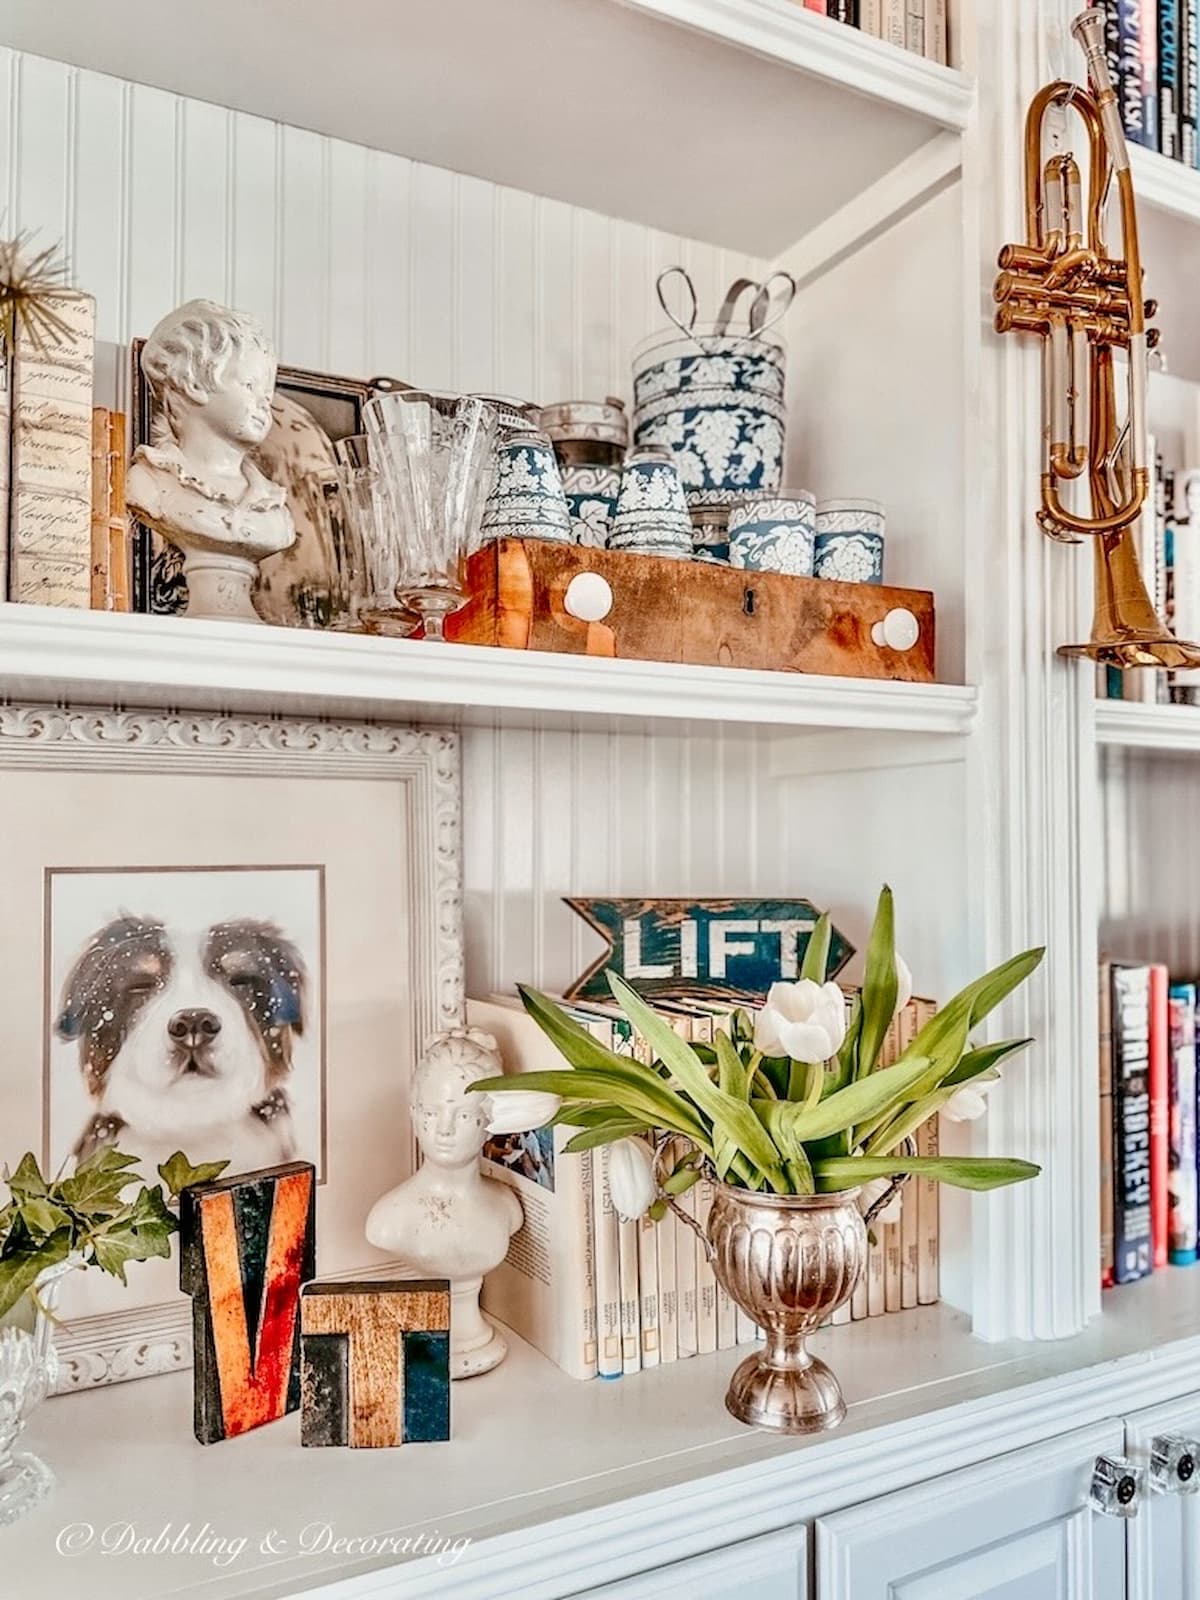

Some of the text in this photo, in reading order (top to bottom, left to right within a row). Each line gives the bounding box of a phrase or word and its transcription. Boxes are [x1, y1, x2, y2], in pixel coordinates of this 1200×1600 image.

[623, 919, 814, 979] LIFT
[1122, 1093, 1151, 1206] HOCKEY
[201, 1171, 311, 1437] V
[301, 1291, 450, 1448] T
